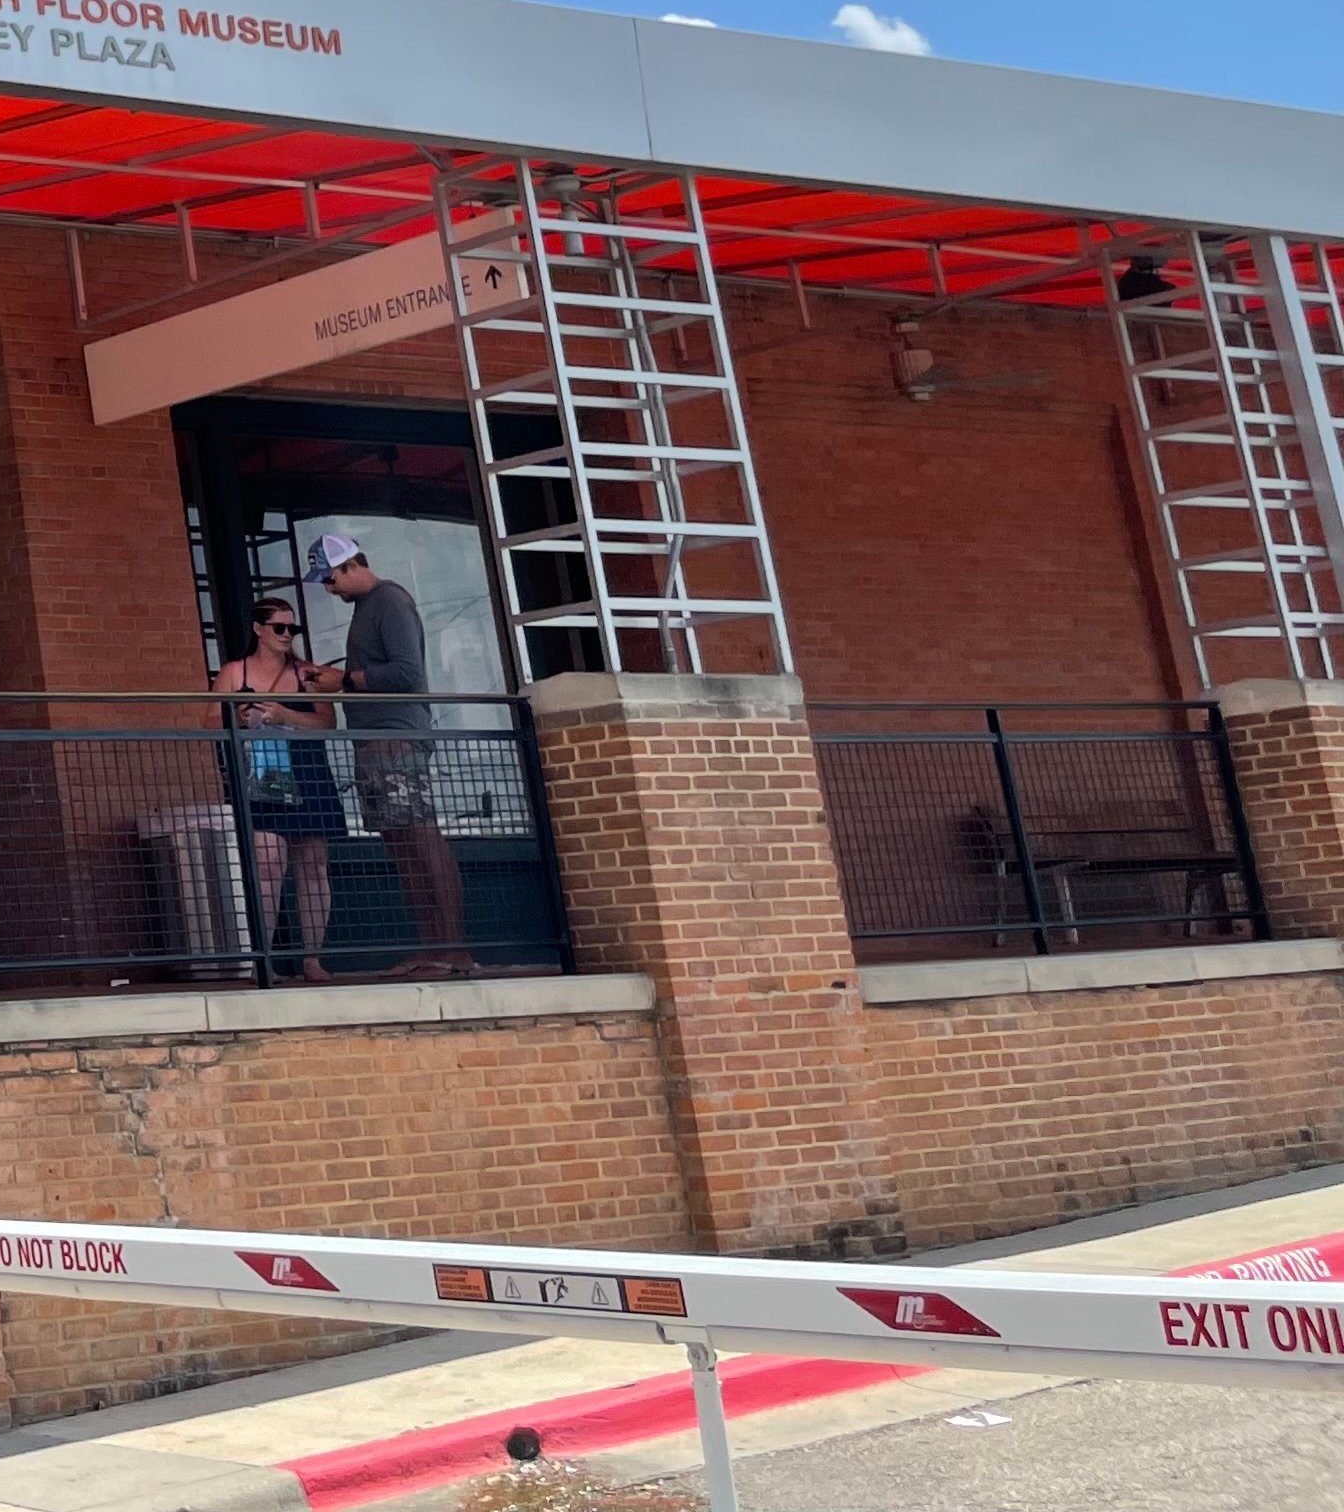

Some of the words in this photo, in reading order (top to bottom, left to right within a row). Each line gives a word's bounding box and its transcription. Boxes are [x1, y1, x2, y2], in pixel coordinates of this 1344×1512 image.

[50, 28, 176, 71] PLAZA
[178, 7, 342, 56] MUSEUM
[314, 302, 382, 340] MUSEUM
[385, 275, 473, 320] ENTRANE
[17, 1237, 54, 1269] NOT
[60, 1239, 129, 1275] BLOCK
[1158, 1301, 1251, 1351] EXIT
[1266, 1304, 1344, 1355] ONL
